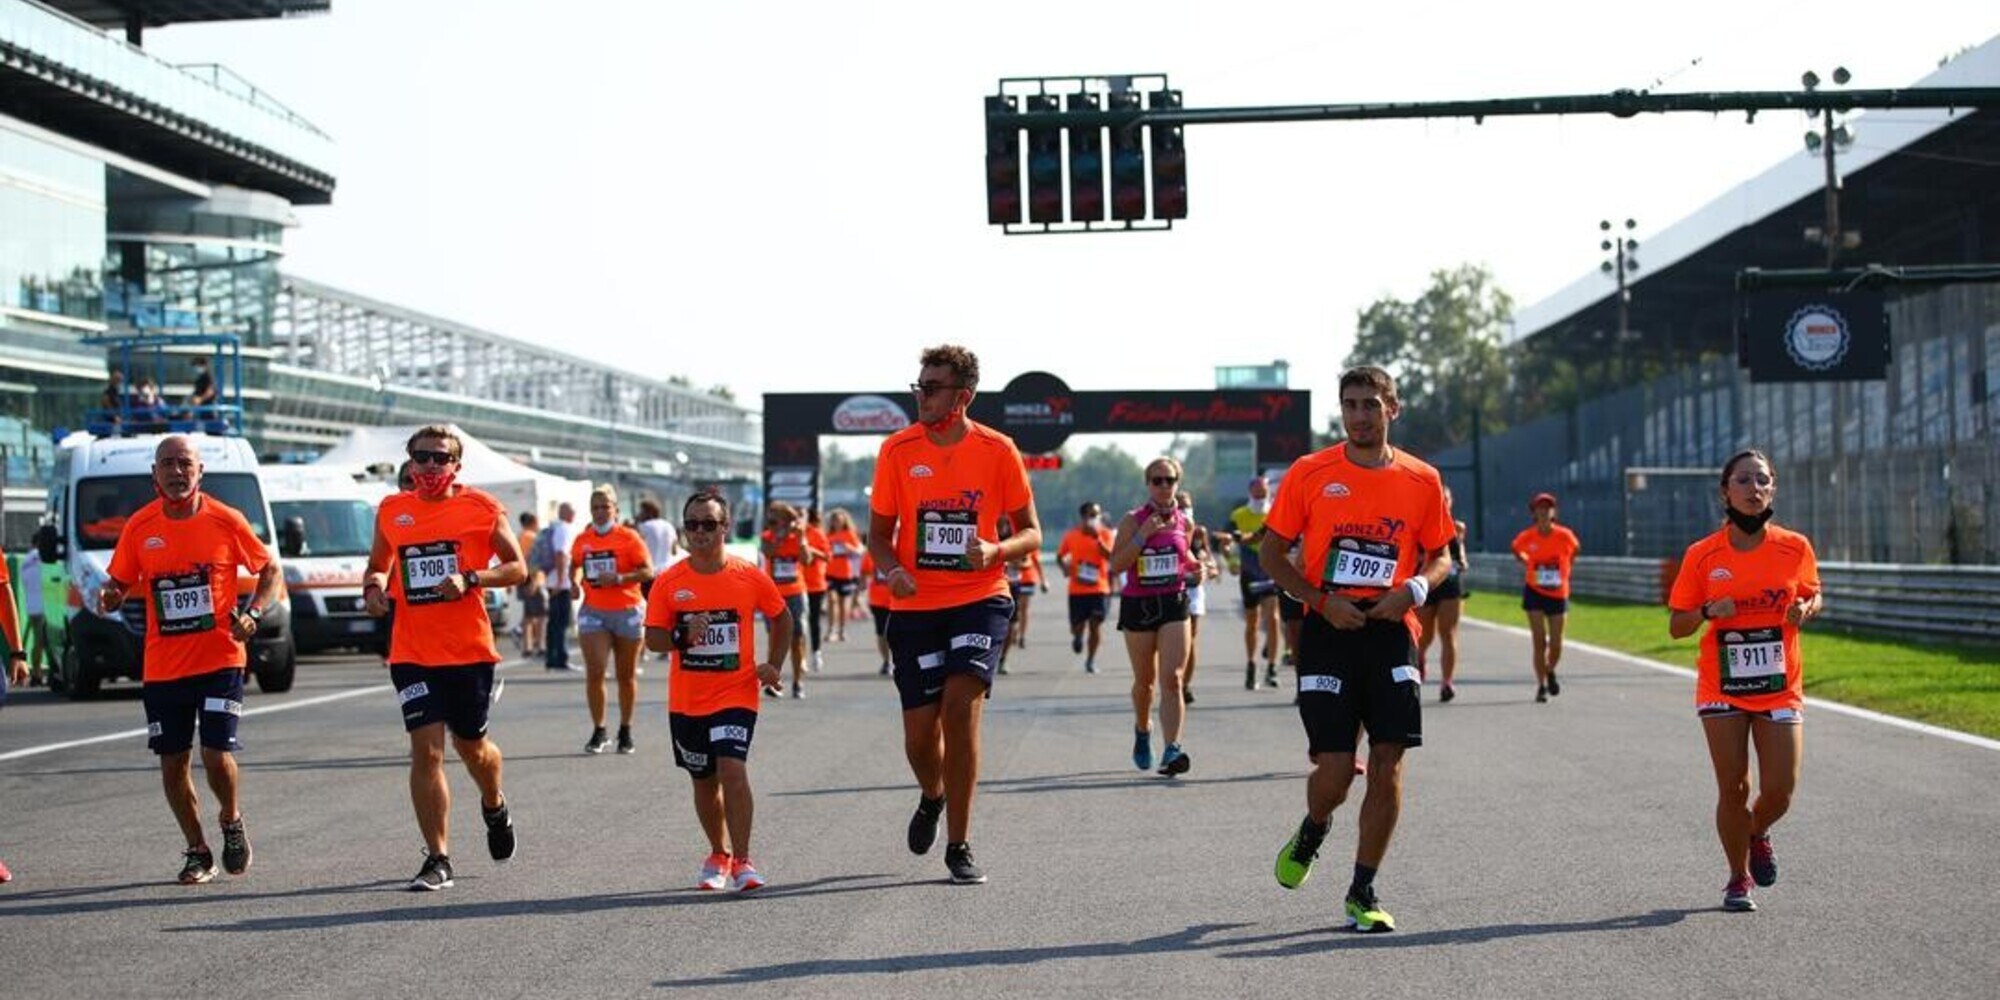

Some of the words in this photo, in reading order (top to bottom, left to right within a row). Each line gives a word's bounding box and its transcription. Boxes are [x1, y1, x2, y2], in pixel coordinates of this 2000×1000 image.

[938, 527, 963, 545] 900
[1333, 523, 1385, 537] MONZA
[420, 559, 445, 577] 908
[1351, 557, 1380, 579] 909
[174, 591, 199, 609] 899
[966, 634, 988, 646] 900
[1743, 648, 1767, 666] 911
[404, 683, 425, 699] 908
[1316, 675, 1339, 690] 909
[724, 725, 745, 739] 906
